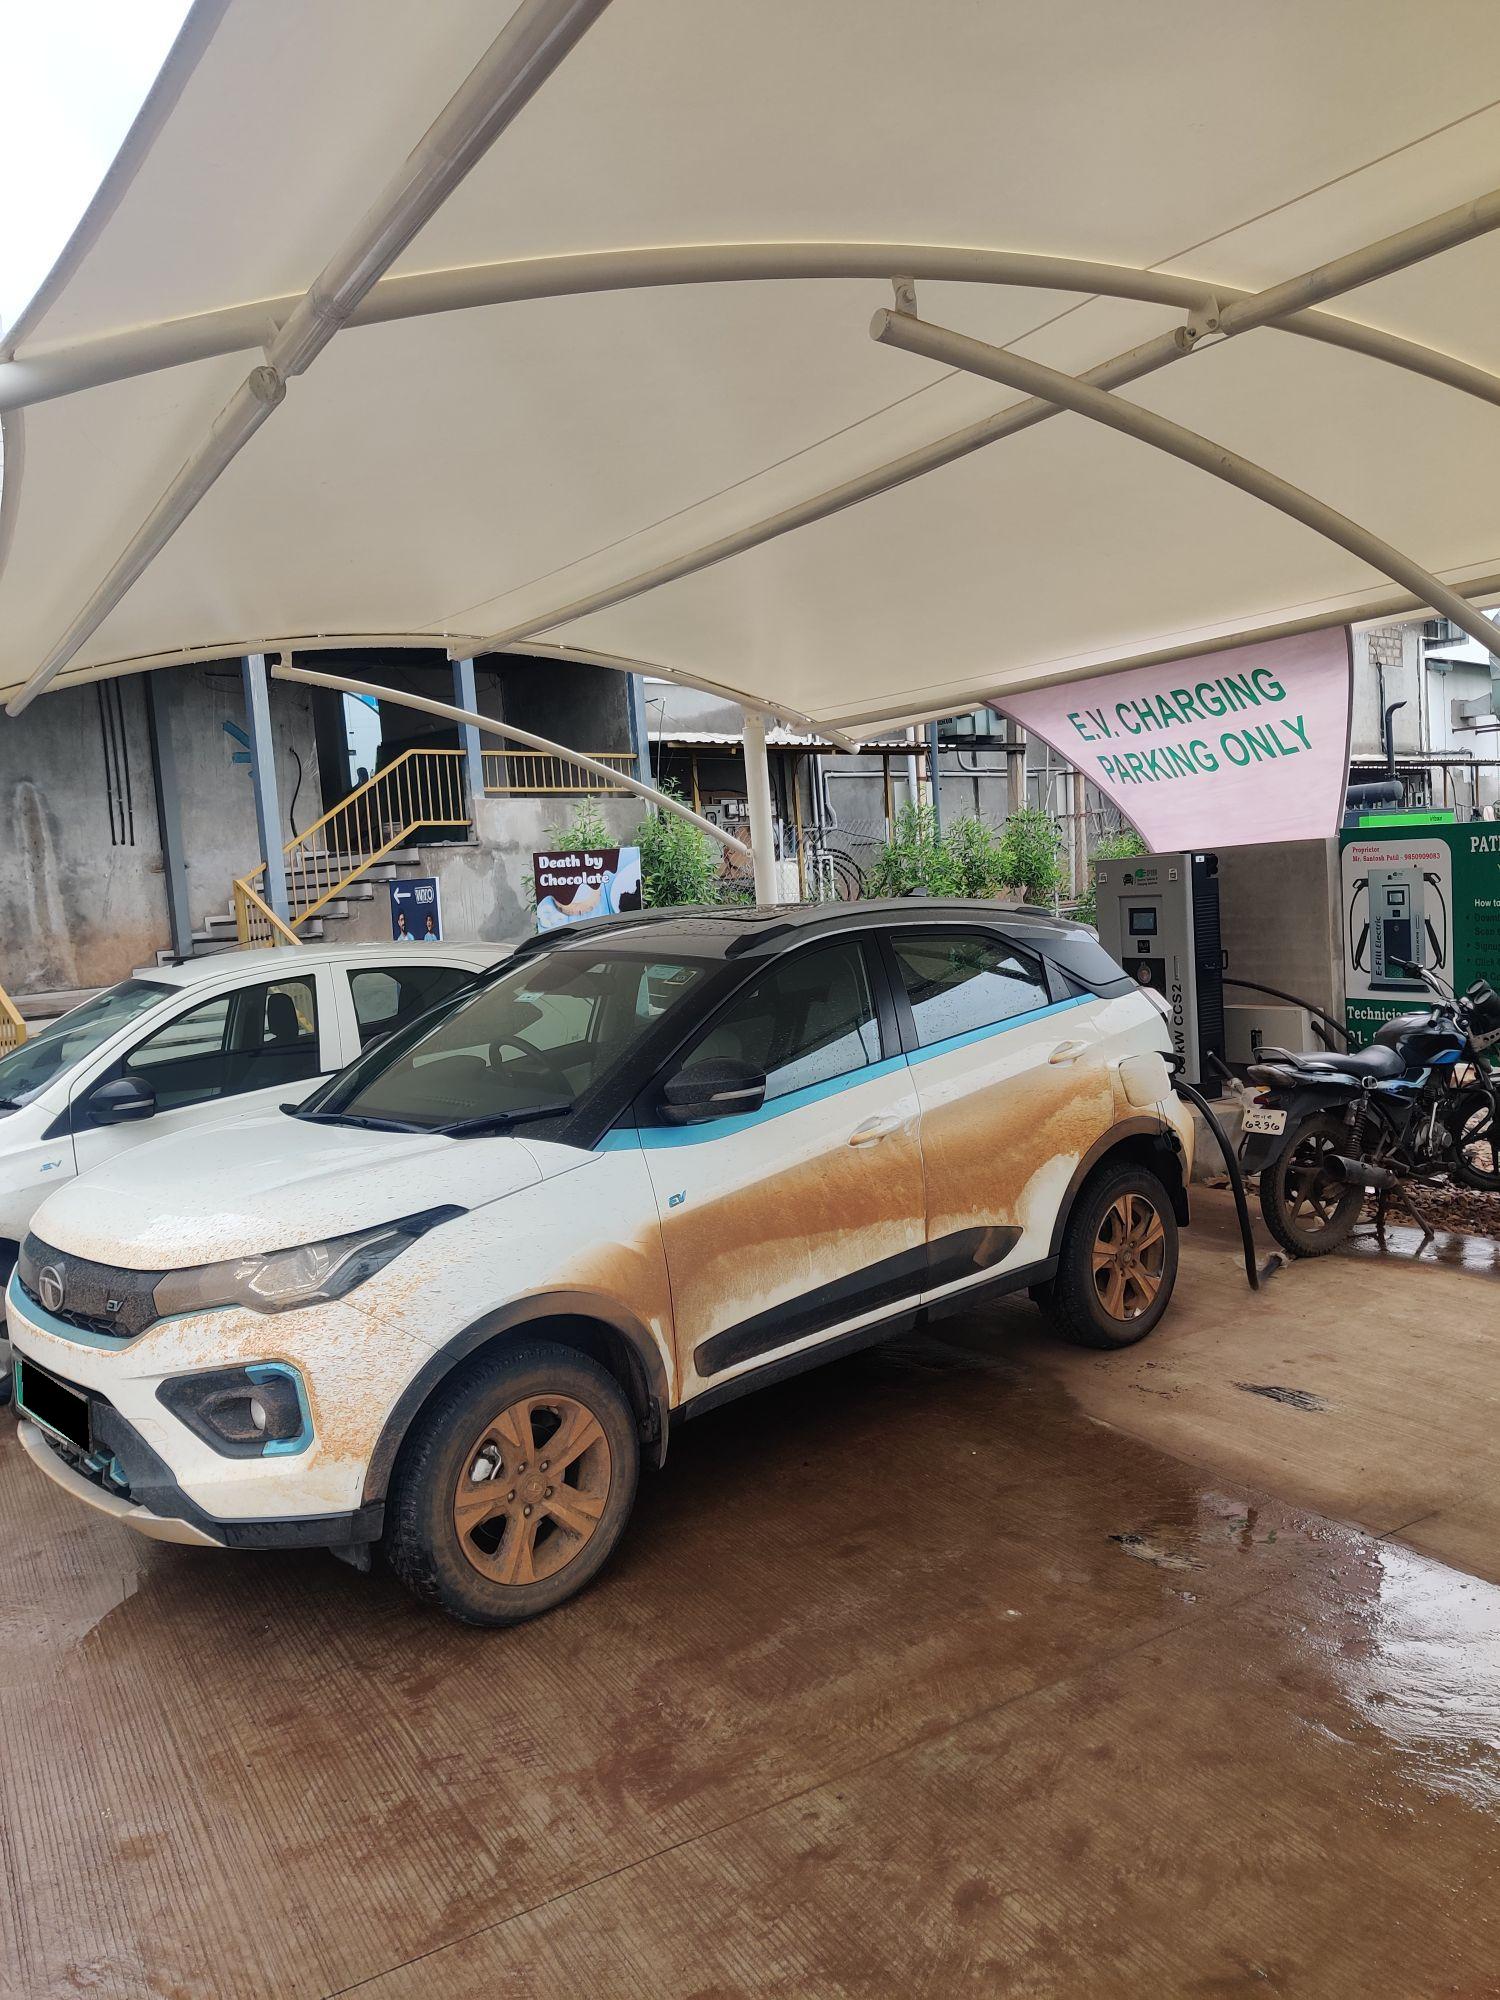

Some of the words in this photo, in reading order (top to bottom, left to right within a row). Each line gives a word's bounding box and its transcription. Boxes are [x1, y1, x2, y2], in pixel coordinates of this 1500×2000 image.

[1067, 708, 1119, 741] E.V.
[1115, 668, 1287, 735] CHARGING
[1097, 739, 1220, 785] PARKING
[1219, 714, 1313, 767] ONLY
[1352, 846, 1380, 854] Proprietor
[538, 854, 581, 869] Death
[584, 853, 604, 870] by
[539, 872, 610, 887] Chocolate
[1474, 898, 1492, 907] How
[1171, 983, 1185, 1026] CCS2
[668, 1189, 687, 1208] EV
[106, 1299, 124, 1312] EV
